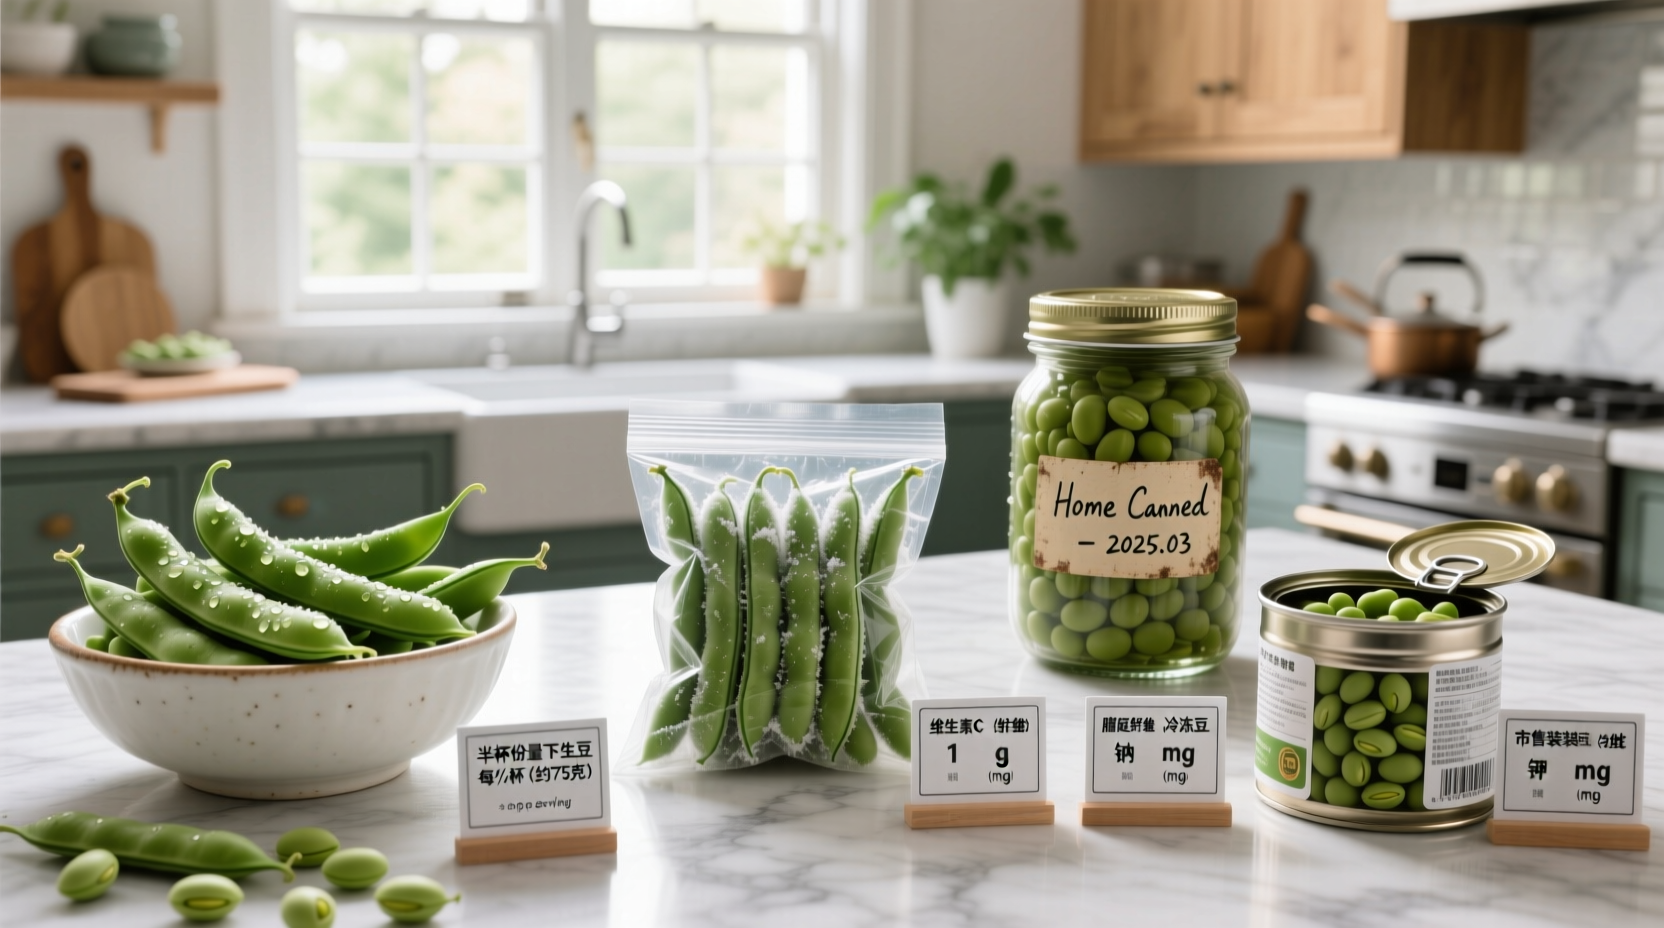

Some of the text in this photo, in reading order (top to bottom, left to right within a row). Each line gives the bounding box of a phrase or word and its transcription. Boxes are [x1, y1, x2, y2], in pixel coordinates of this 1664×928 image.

[1053, 480, 1210, 520] Home Canned
[1105, 532, 1192, 556] 2025.03
[476, 740, 593, 764] 半杯份量下生豆
[947, 742, 1009, 769] 1 g
[1114, 742, 1195, 768] 钠 mg
[1574, 763, 1611, 787] mg
